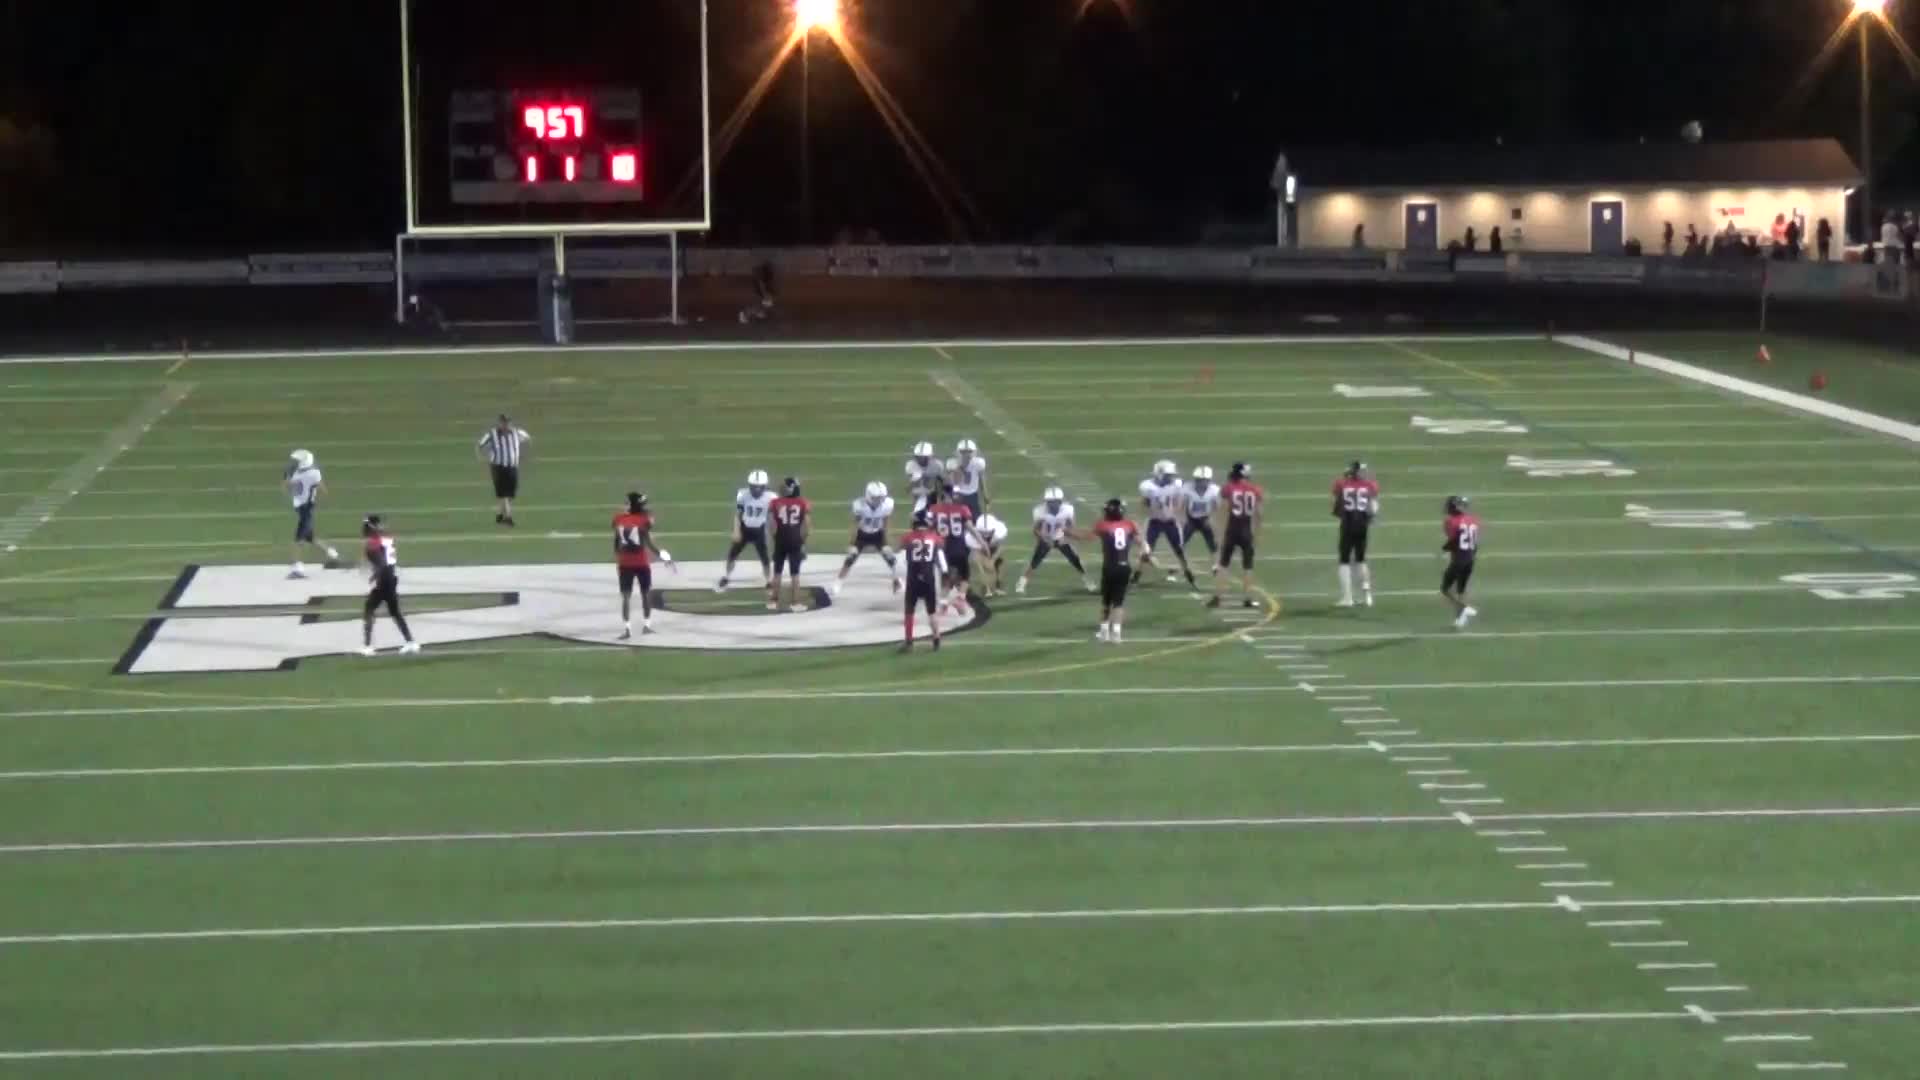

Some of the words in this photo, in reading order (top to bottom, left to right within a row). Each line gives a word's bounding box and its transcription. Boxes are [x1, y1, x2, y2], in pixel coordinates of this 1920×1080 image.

[778, 504, 802, 525] 42
[1231, 490, 1256, 516] 50
[618, 524, 641, 546] 14
[1113, 526, 1127, 550] 8
[1459, 522, 1479, 550] 20
[911, 539, 935, 562] 23
